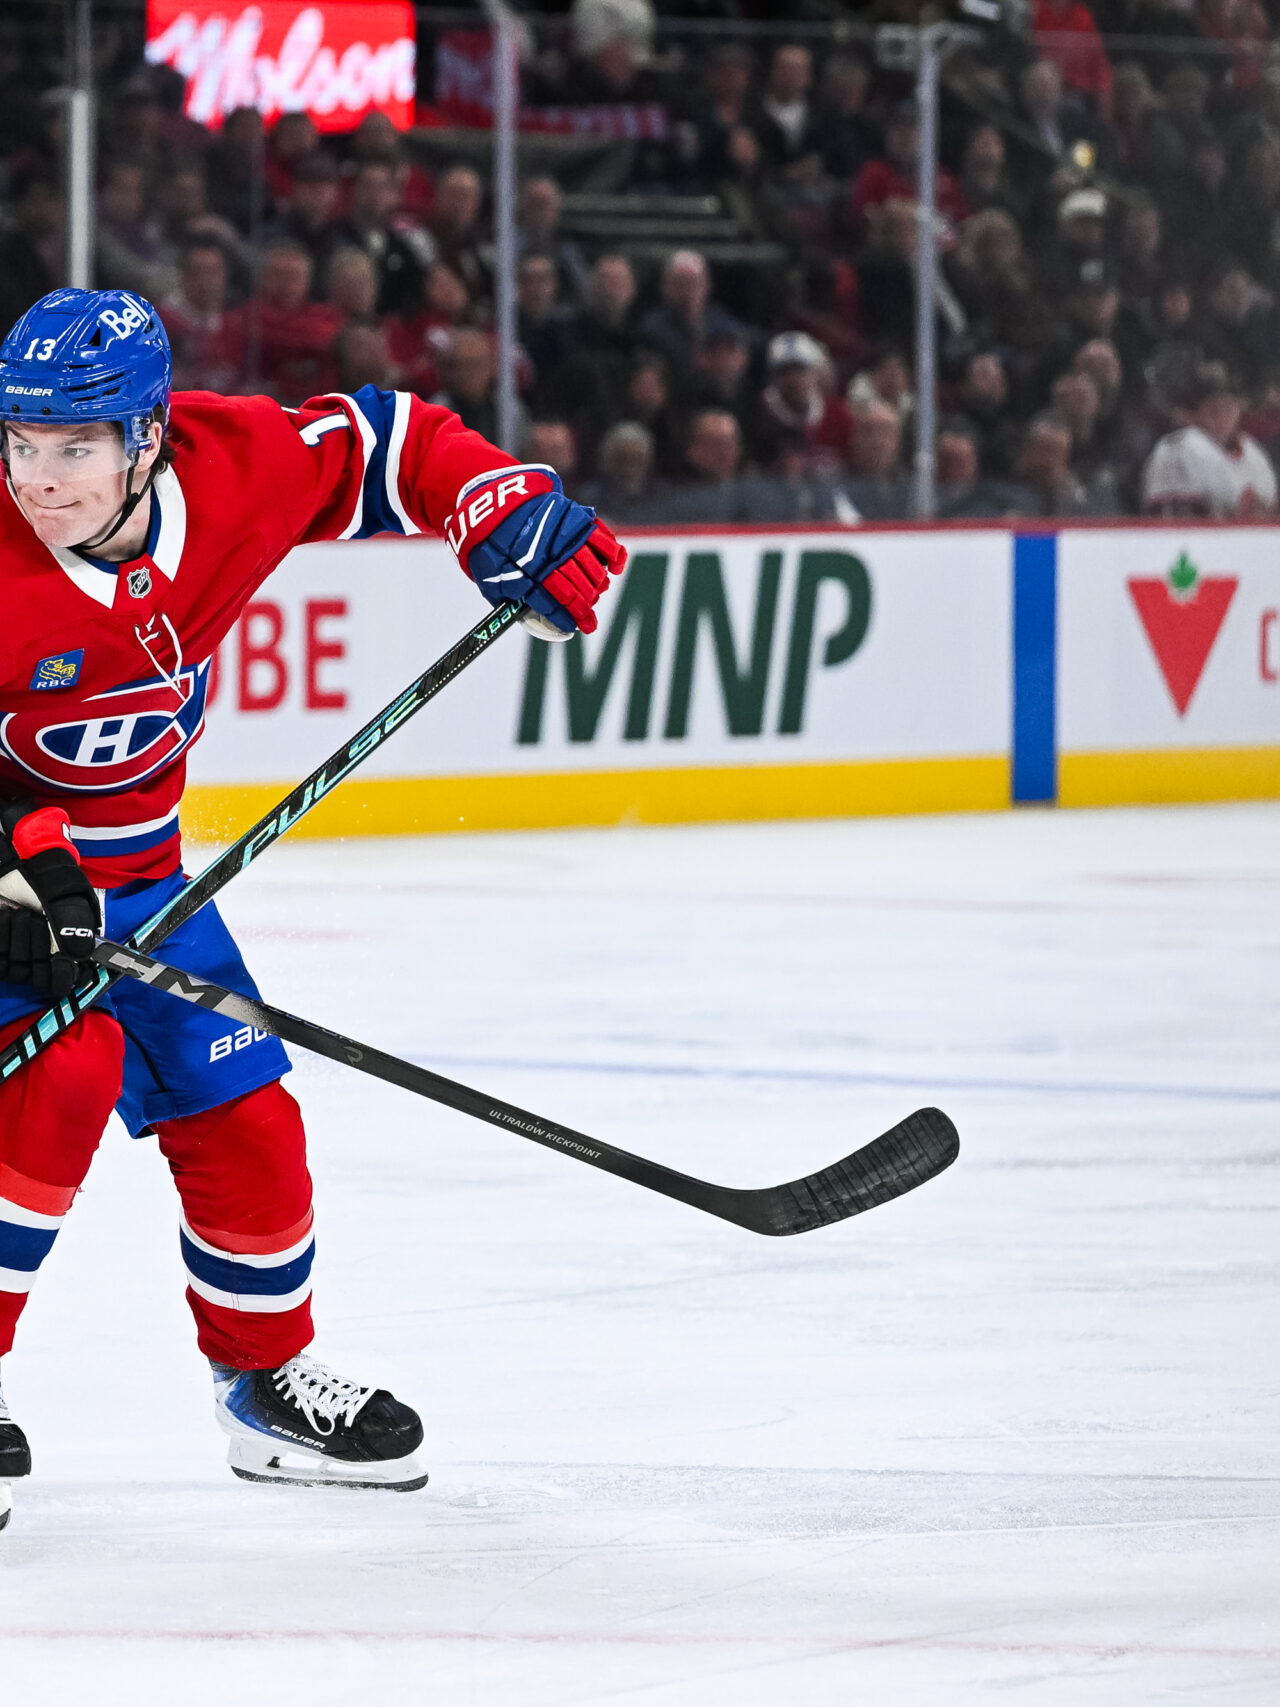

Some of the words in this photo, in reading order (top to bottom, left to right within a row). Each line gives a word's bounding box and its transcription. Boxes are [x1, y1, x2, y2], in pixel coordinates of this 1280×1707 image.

[145, 3, 414, 123] Molson
[99, 293, 149, 340] Bell
[23, 338, 56, 361] 13
[5, 385, 53, 397] BAUER
[445, 474, 529, 556] UER
[206, 596, 348, 713] BE
[514, 549, 874, 744] MNP
[36, 677, 71, 689] RBC
[241, 674, 424, 868] PULSE
[209, 1025, 271, 1063] BAU
[489, 1109, 546, 1136] ULTRALOW
[545, 1132, 603, 1159] KICKPOINT
[270, 1424, 326, 1449] BAUER
